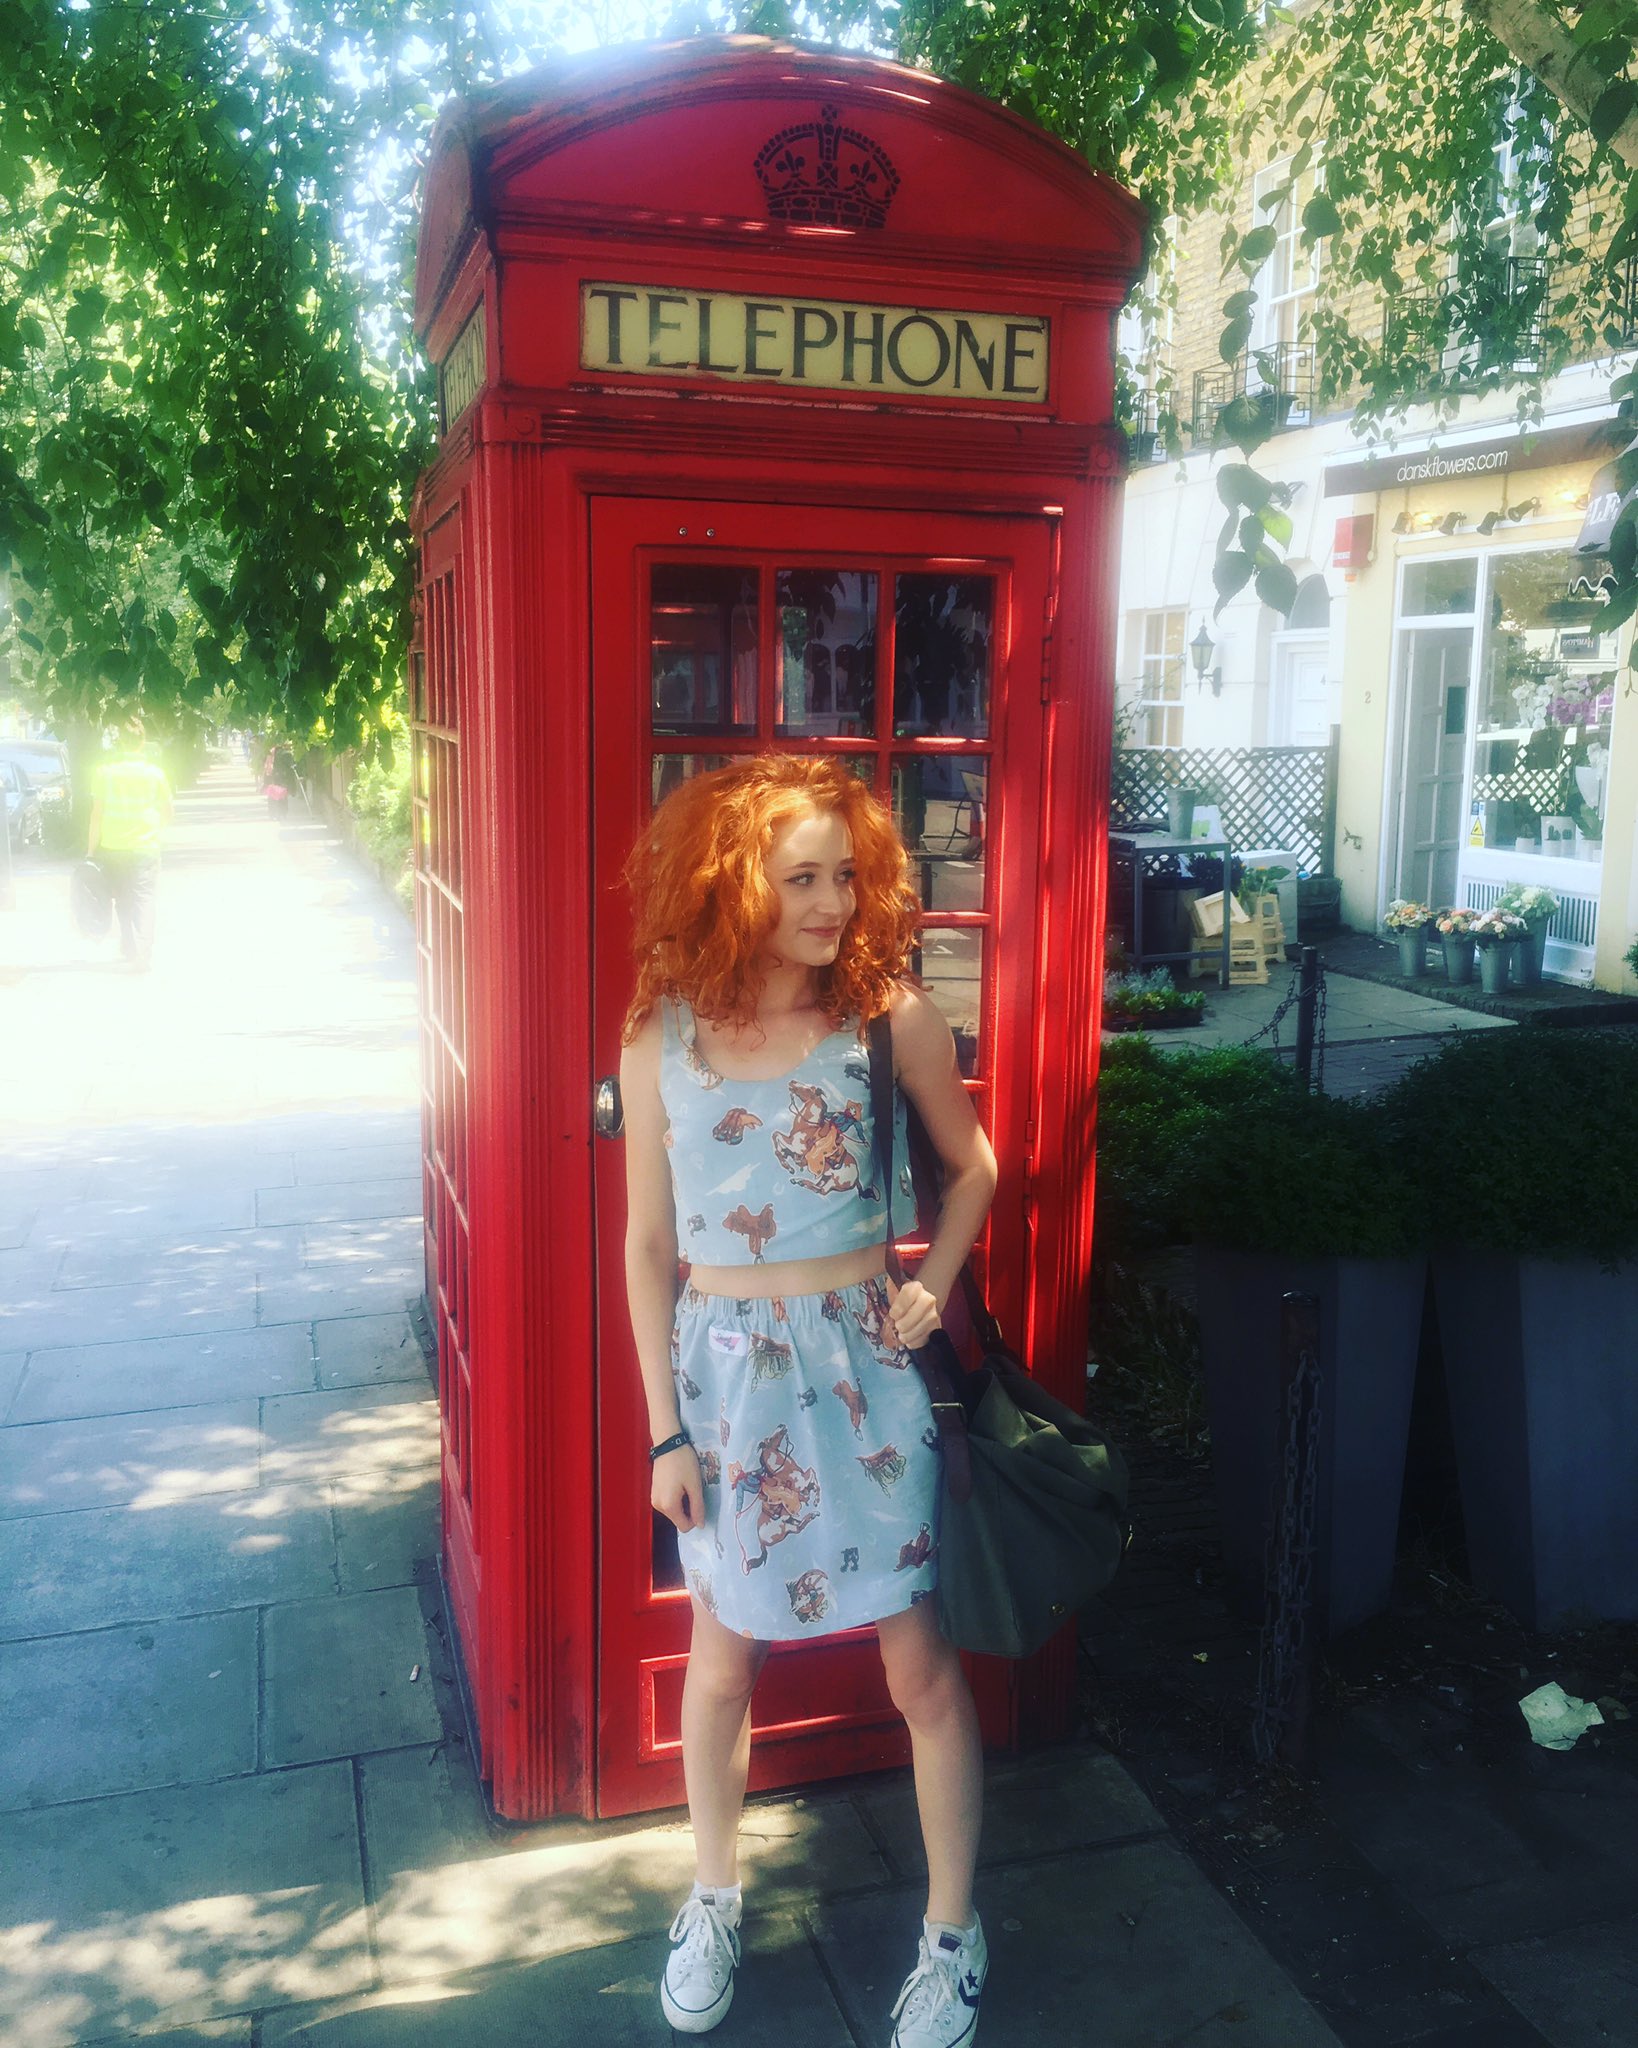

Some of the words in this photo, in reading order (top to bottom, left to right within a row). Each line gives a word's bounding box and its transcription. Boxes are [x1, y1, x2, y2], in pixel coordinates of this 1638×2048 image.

[589, 288, 1044, 394] TELEPHONE
[1397, 450, 1509, 482] danskflowers.com
[1364, 690, 1372, 704] 2
